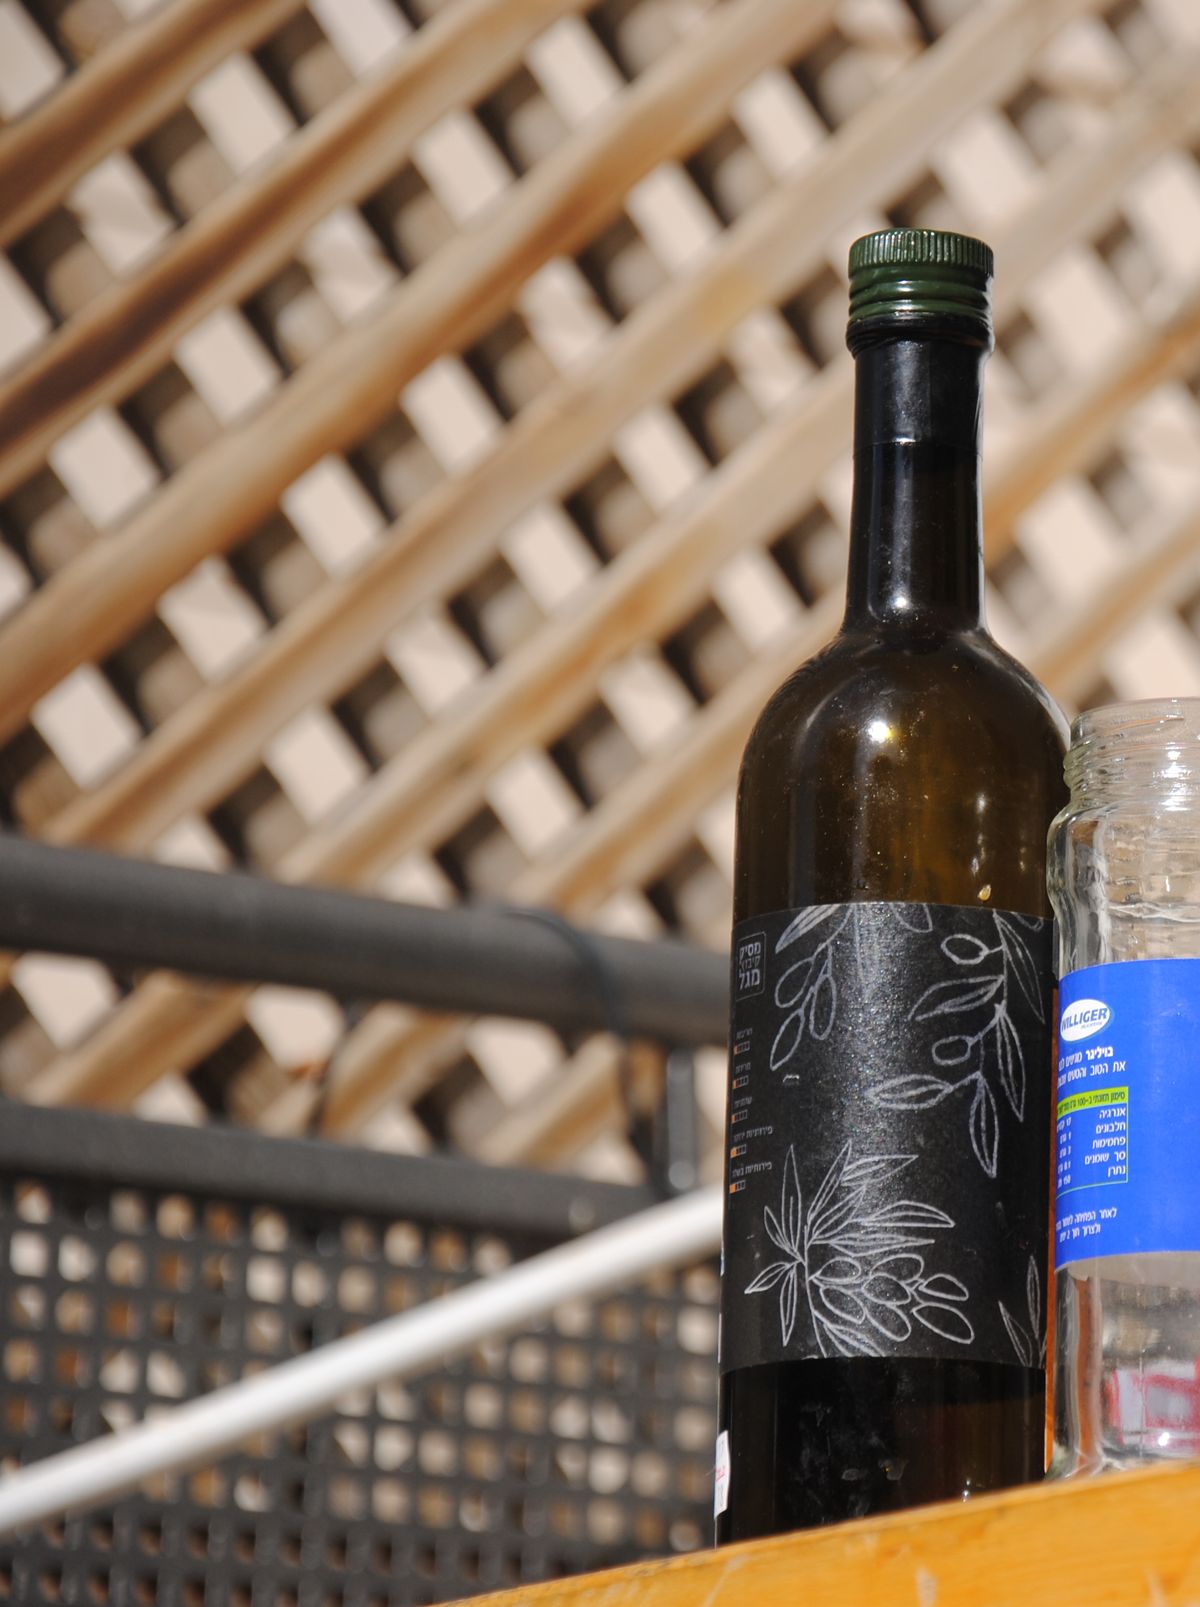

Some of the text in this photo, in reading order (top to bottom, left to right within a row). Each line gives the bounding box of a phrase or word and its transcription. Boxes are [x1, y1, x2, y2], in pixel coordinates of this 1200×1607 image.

[740, 942, 761, 965] מסיק
[739, 968, 760, 990] מגל
[1090, 1063, 1108, 1076] הטוב
[1113, 1061, 1126, 1072] את
[1099, 1107, 1126, 1119] אנרגיה
[1096, 1121, 1125, 1134] חלבונים
[1092, 1136, 1125, 1149] פחמימות
[1085, 1152, 1109, 1165] שומנים
[1114, 1151, 1125, 1162] סך
[1108, 1165, 1125, 1177] נתרן
